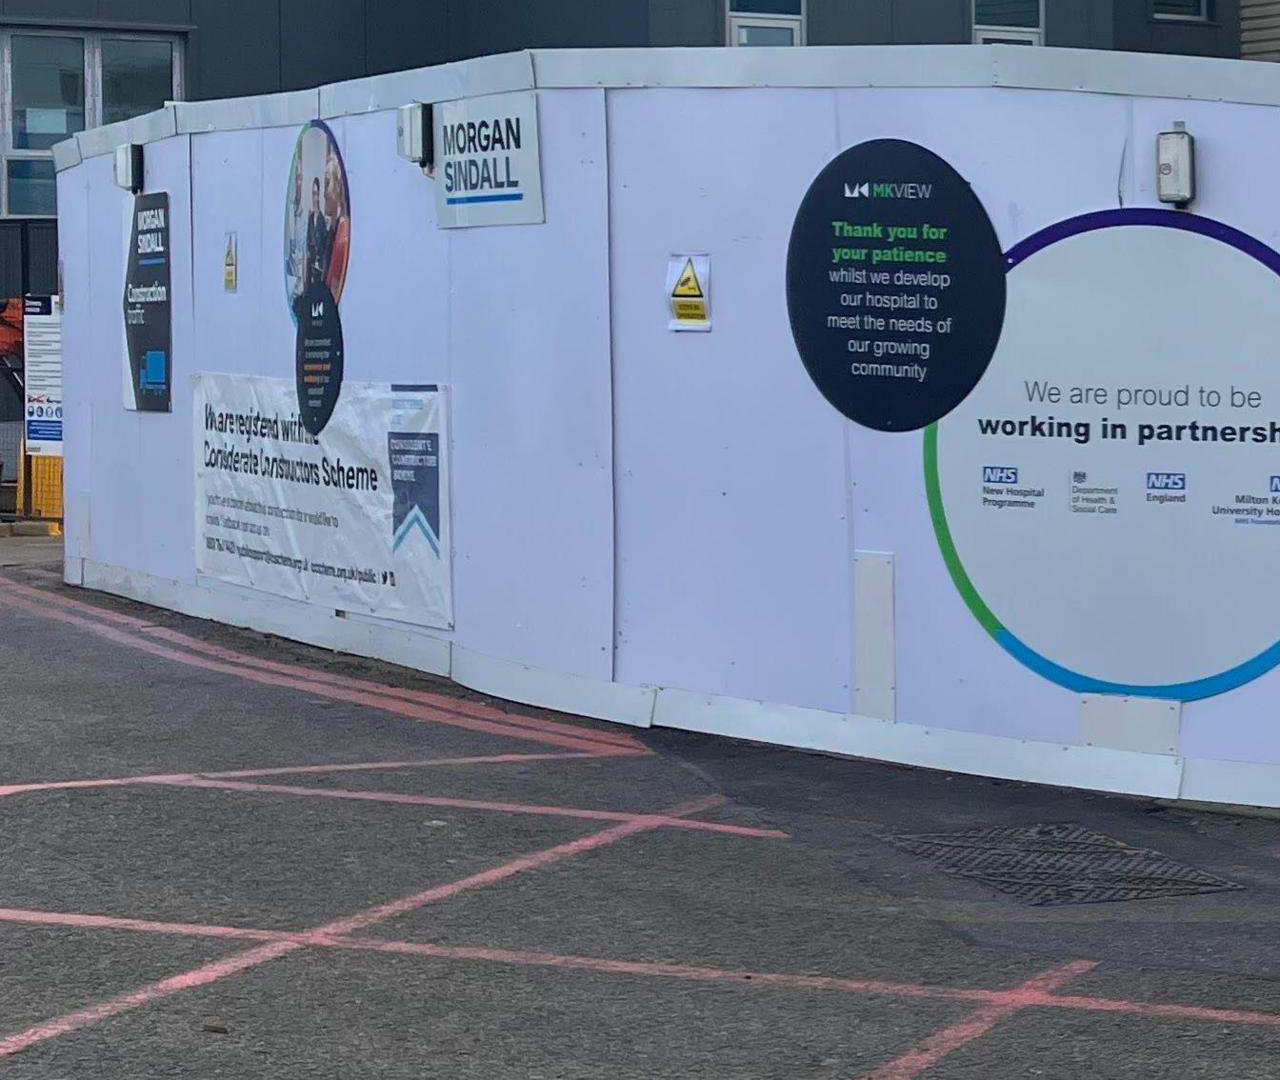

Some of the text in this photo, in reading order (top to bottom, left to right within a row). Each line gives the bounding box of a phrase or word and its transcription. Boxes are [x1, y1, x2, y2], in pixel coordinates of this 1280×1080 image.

[442, 117, 522, 156] MORGAN
[445, 156, 519, 193] SINDALL
[832, 221, 948, 242] Thank you for
[832, 246, 947, 264] your patience
[829, 267, 951, 290] whilst we develop
[840, 291, 938, 311] our hospital to
[827, 314, 952, 333] meet the needs of
[847, 339, 930, 360] our growing
[851, 362, 927, 382] community
[1024, 380, 1262, 410] We are proud to be
[978, 416, 1091, 444] working
[1101, 418, 1127, 439] in
[322, 456, 378, 491] Scheme
[983, 467, 1018, 484] NHS
[1147, 473, 1186, 490] NHS
[982, 486, 1044, 498] New Hospital
[1146, 493, 1186, 504] England
[1235, 495, 1269, 505] Milton
[982, 497, 1036, 509] Programme
[1212, 506, 1263, 518] University
